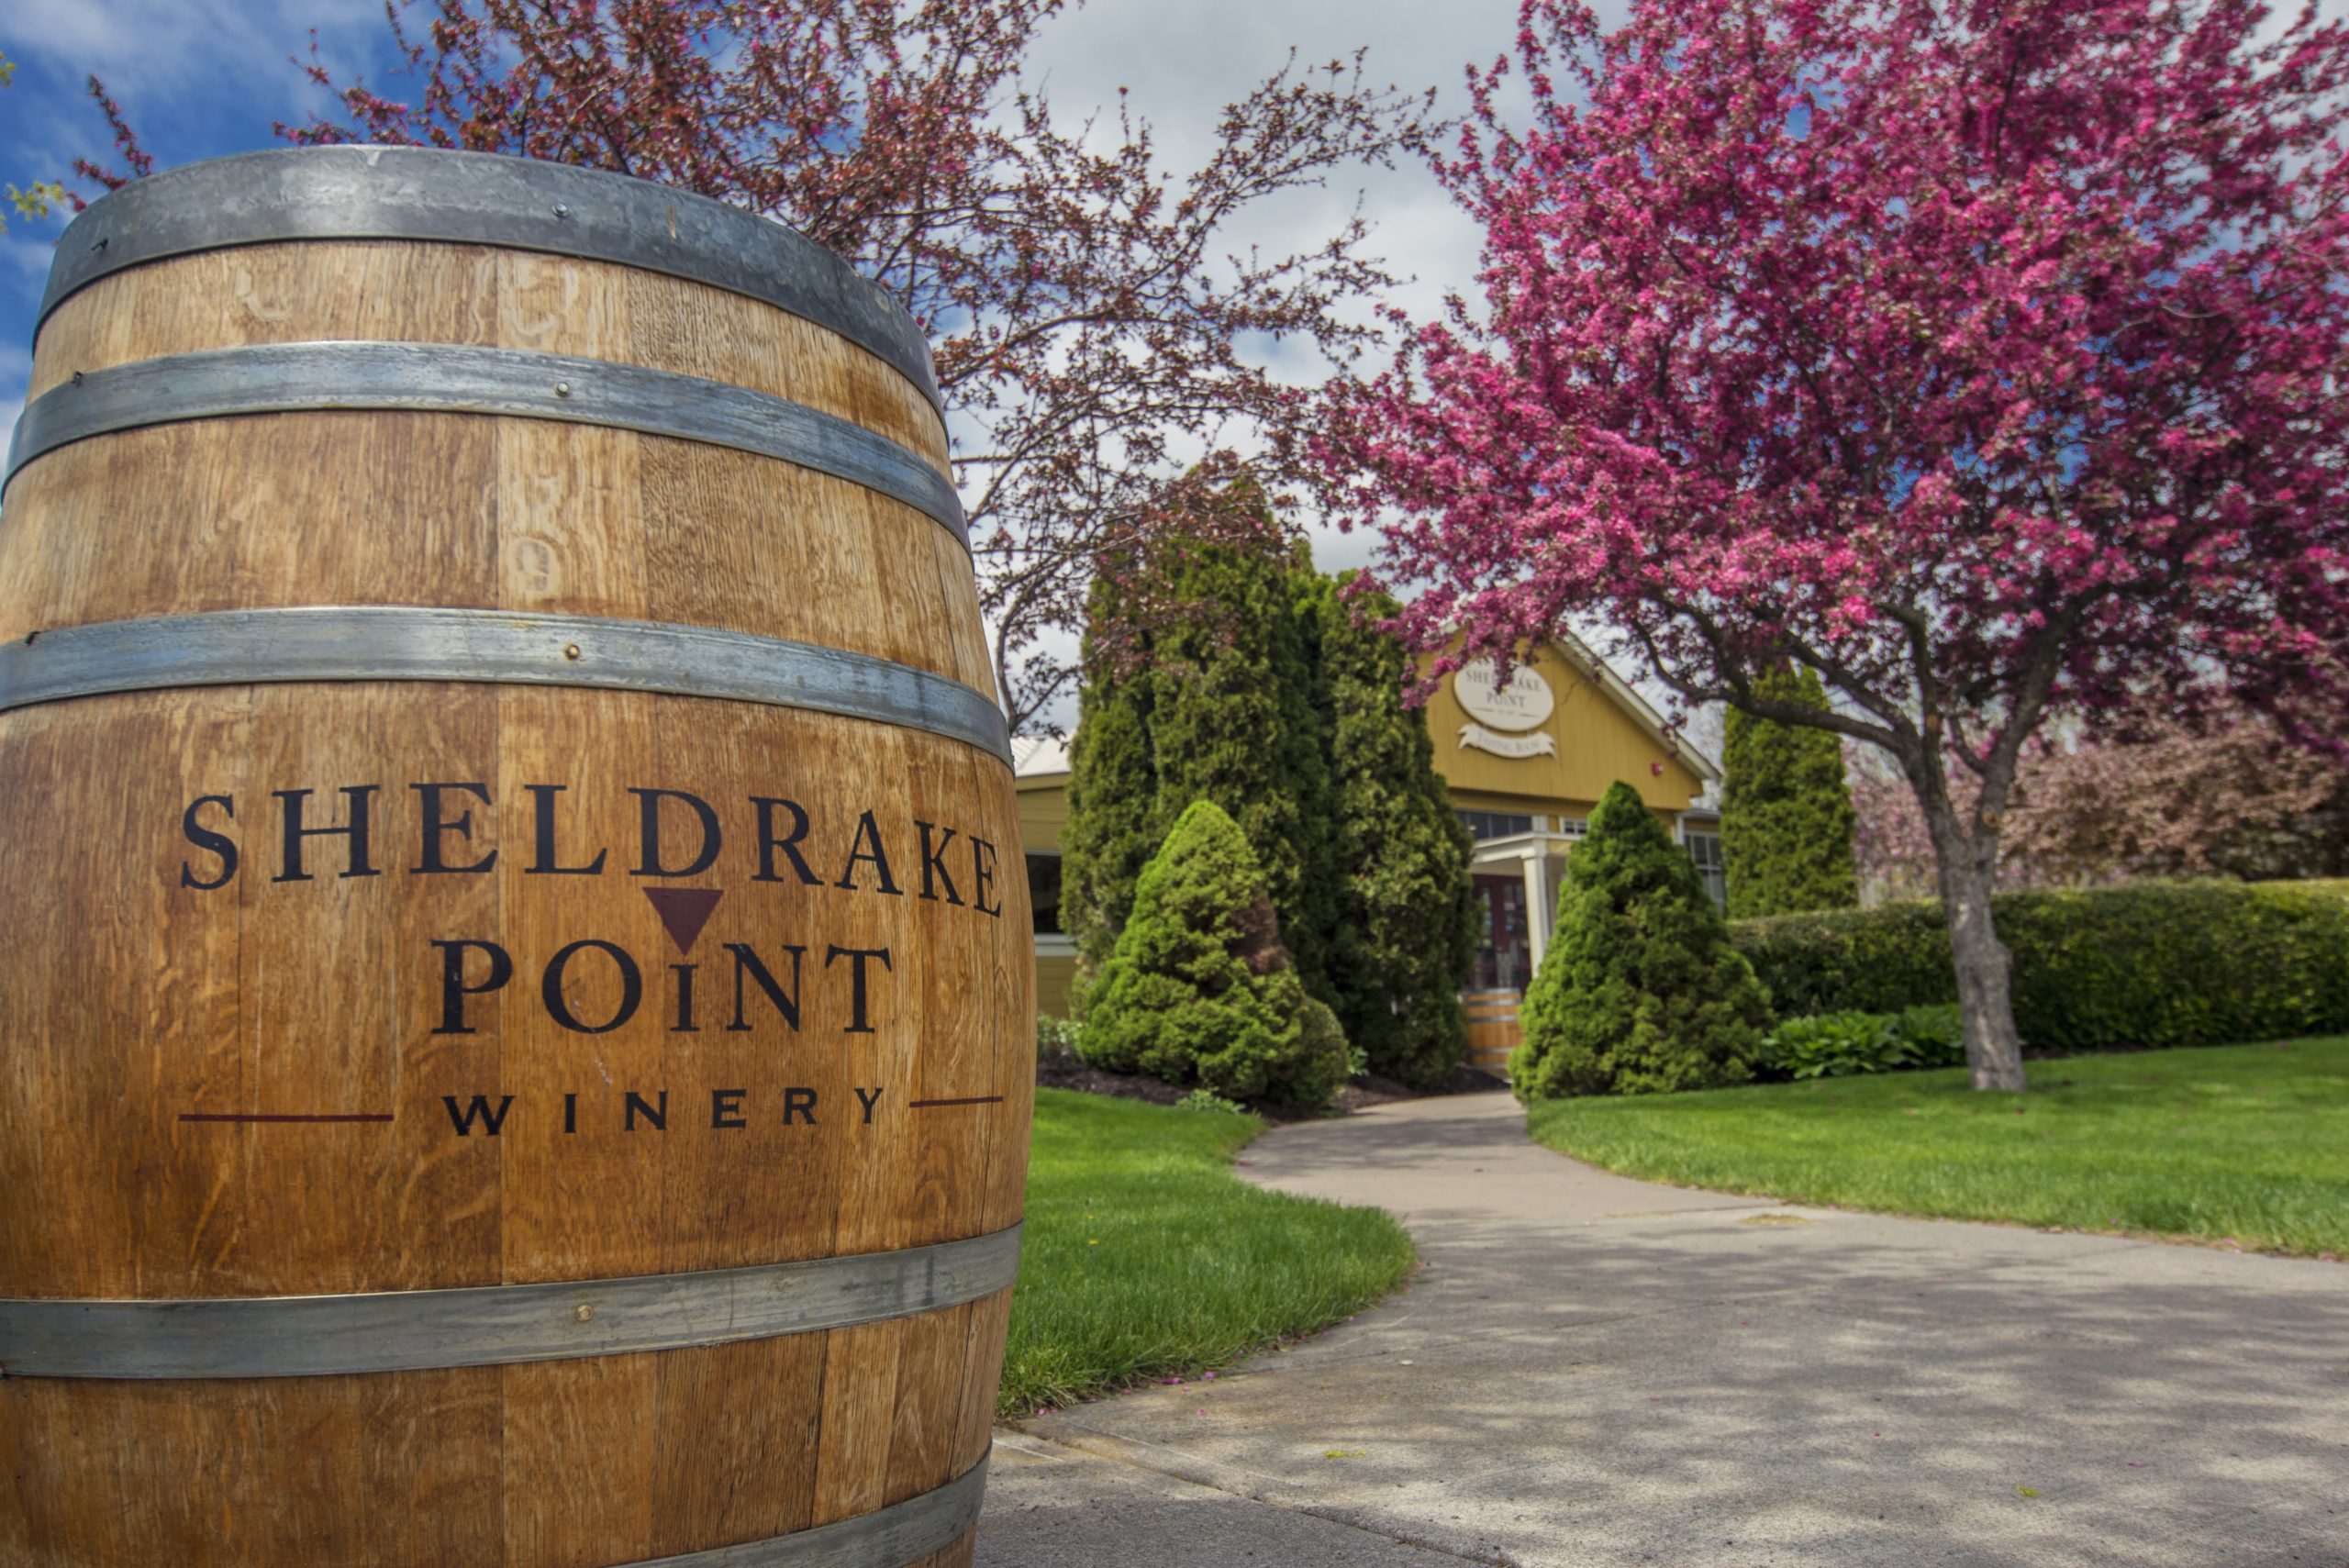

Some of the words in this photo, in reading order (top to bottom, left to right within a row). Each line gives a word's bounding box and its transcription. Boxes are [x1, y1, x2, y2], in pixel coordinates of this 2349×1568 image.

[1486, 691, 1526, 708] POINT
[181, 783, 1001, 918] SHELDRAKE
[430, 940, 892, 1034] POINT
[441, 1087, 883, 1136] WINERY
